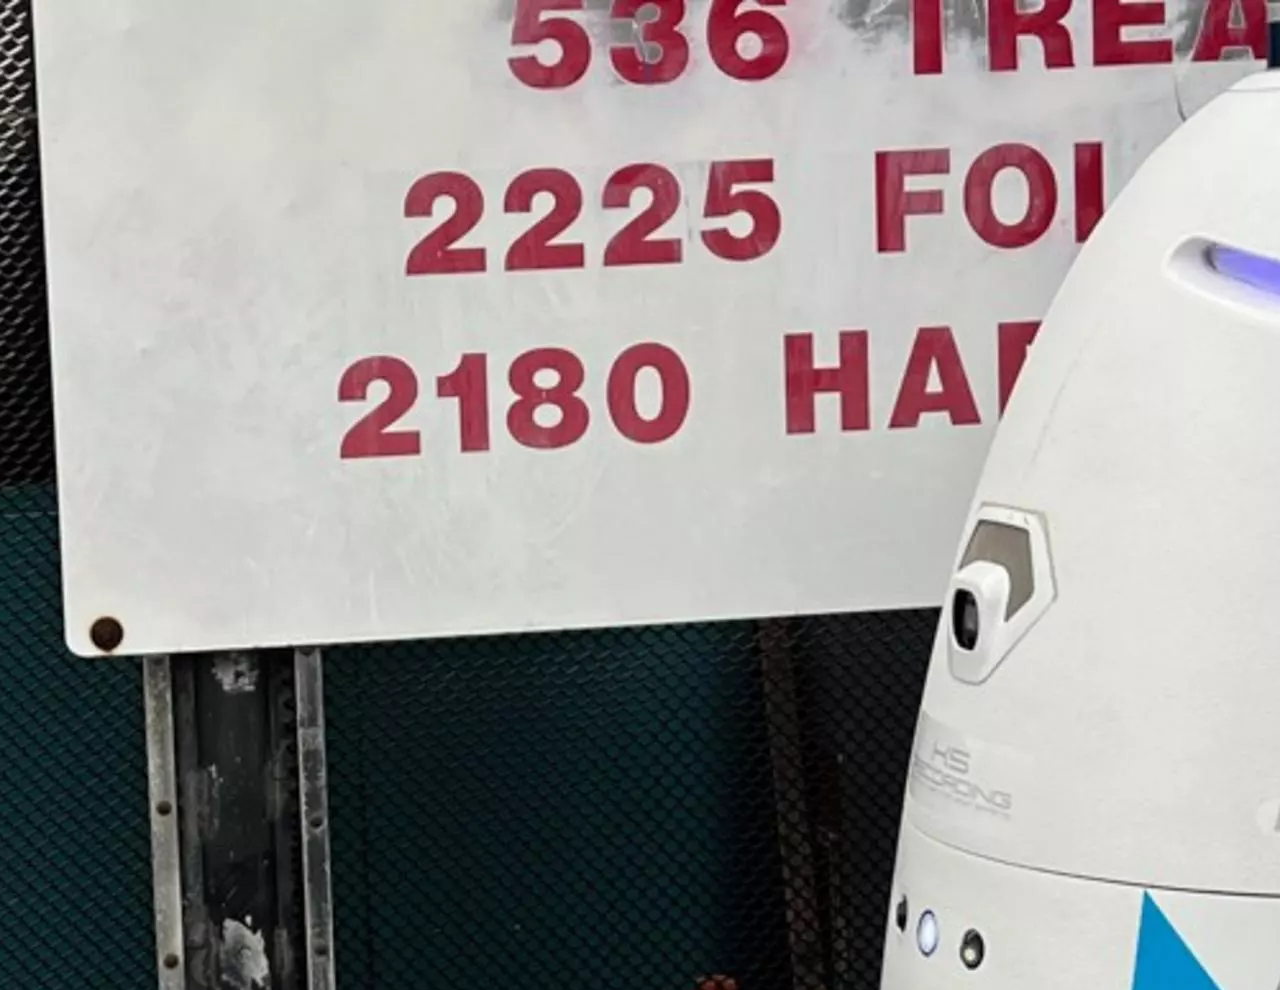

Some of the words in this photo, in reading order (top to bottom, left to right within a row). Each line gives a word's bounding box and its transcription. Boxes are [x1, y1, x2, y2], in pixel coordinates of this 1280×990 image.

[508, 0, 790, 89] 536
[404, 158, 782, 276] 2225
[338, 341, 691, 459] 2180
